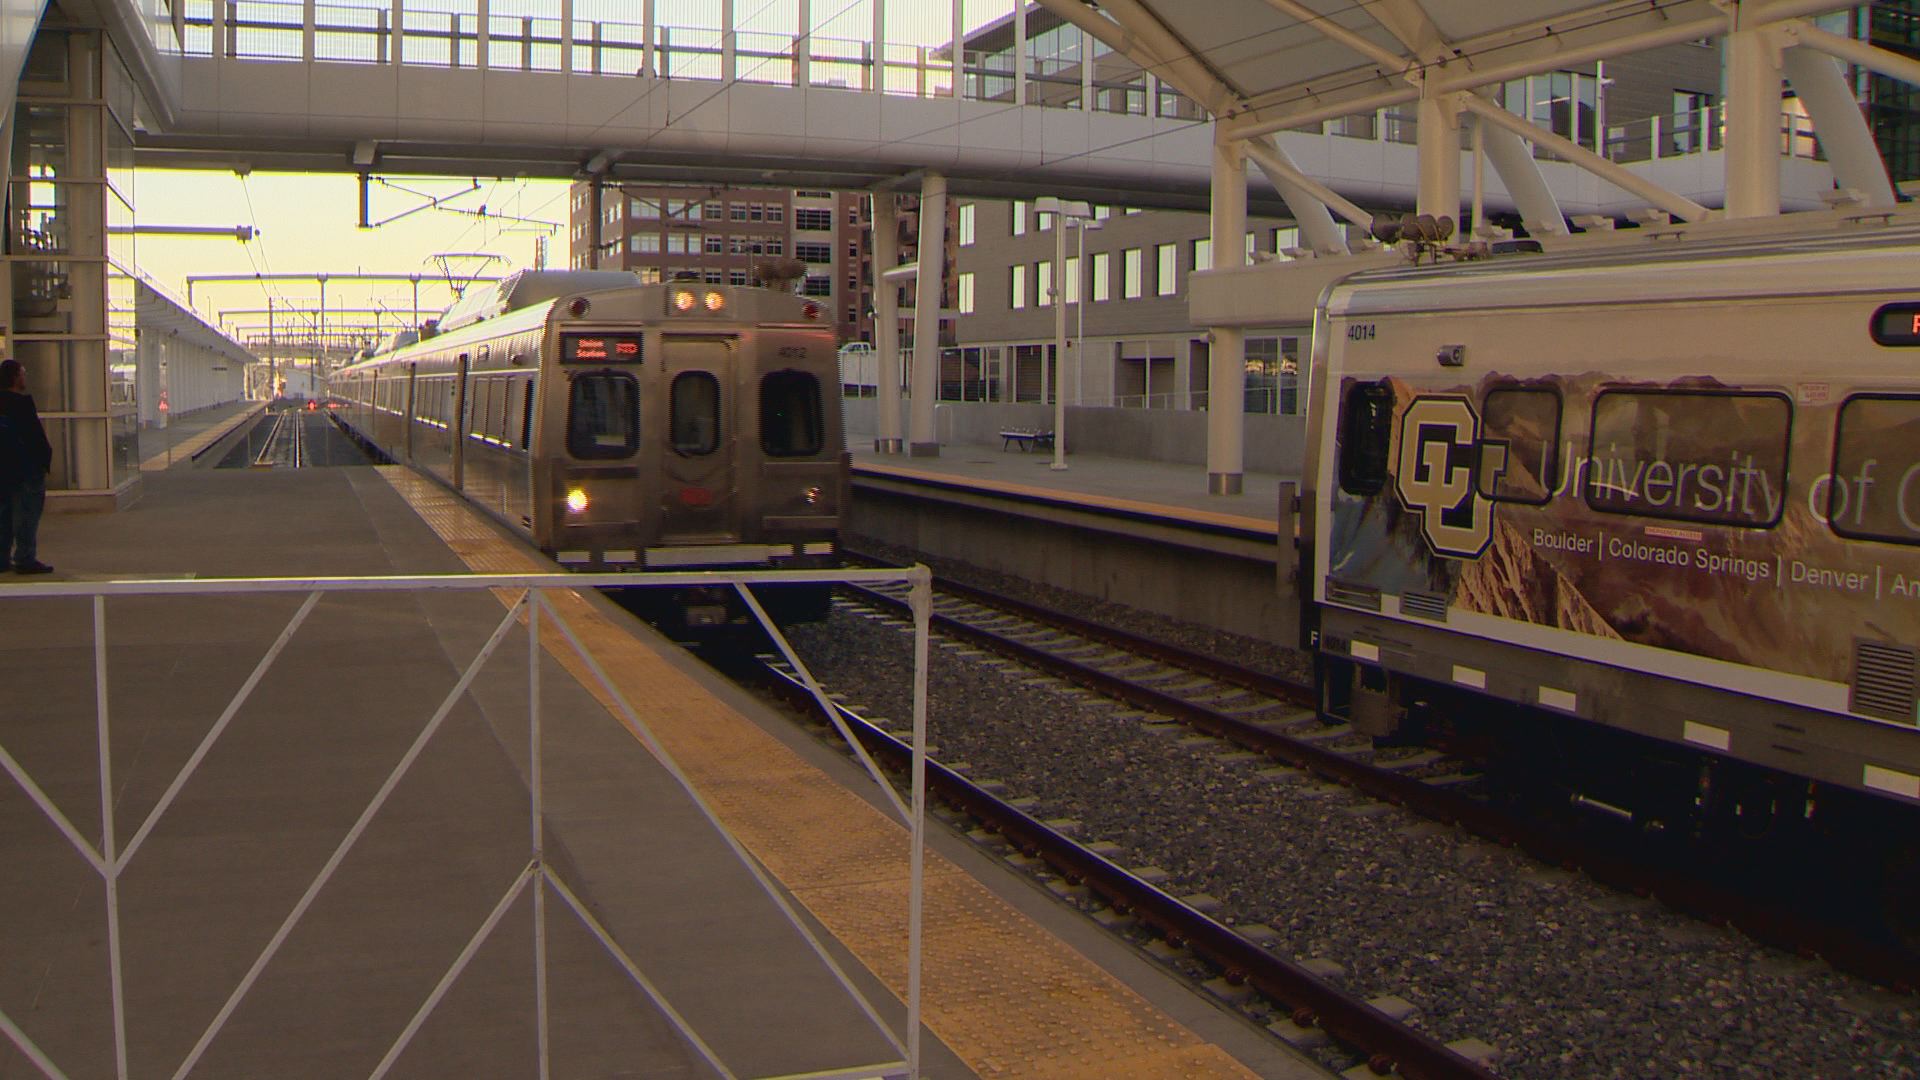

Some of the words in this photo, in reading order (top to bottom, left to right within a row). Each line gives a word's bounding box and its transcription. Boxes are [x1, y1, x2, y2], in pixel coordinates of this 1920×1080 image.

[1348, 324, 1376, 340] 4014
[1539, 440, 1789, 526] University
[1808, 459, 1877, 525] of
[1533, 528, 1593, 553] Boulder
[1609, 539, 1689, 566] Colorado
[1695, 549, 1770, 579] Springs
[1791, 561, 1869, 592] Denver
